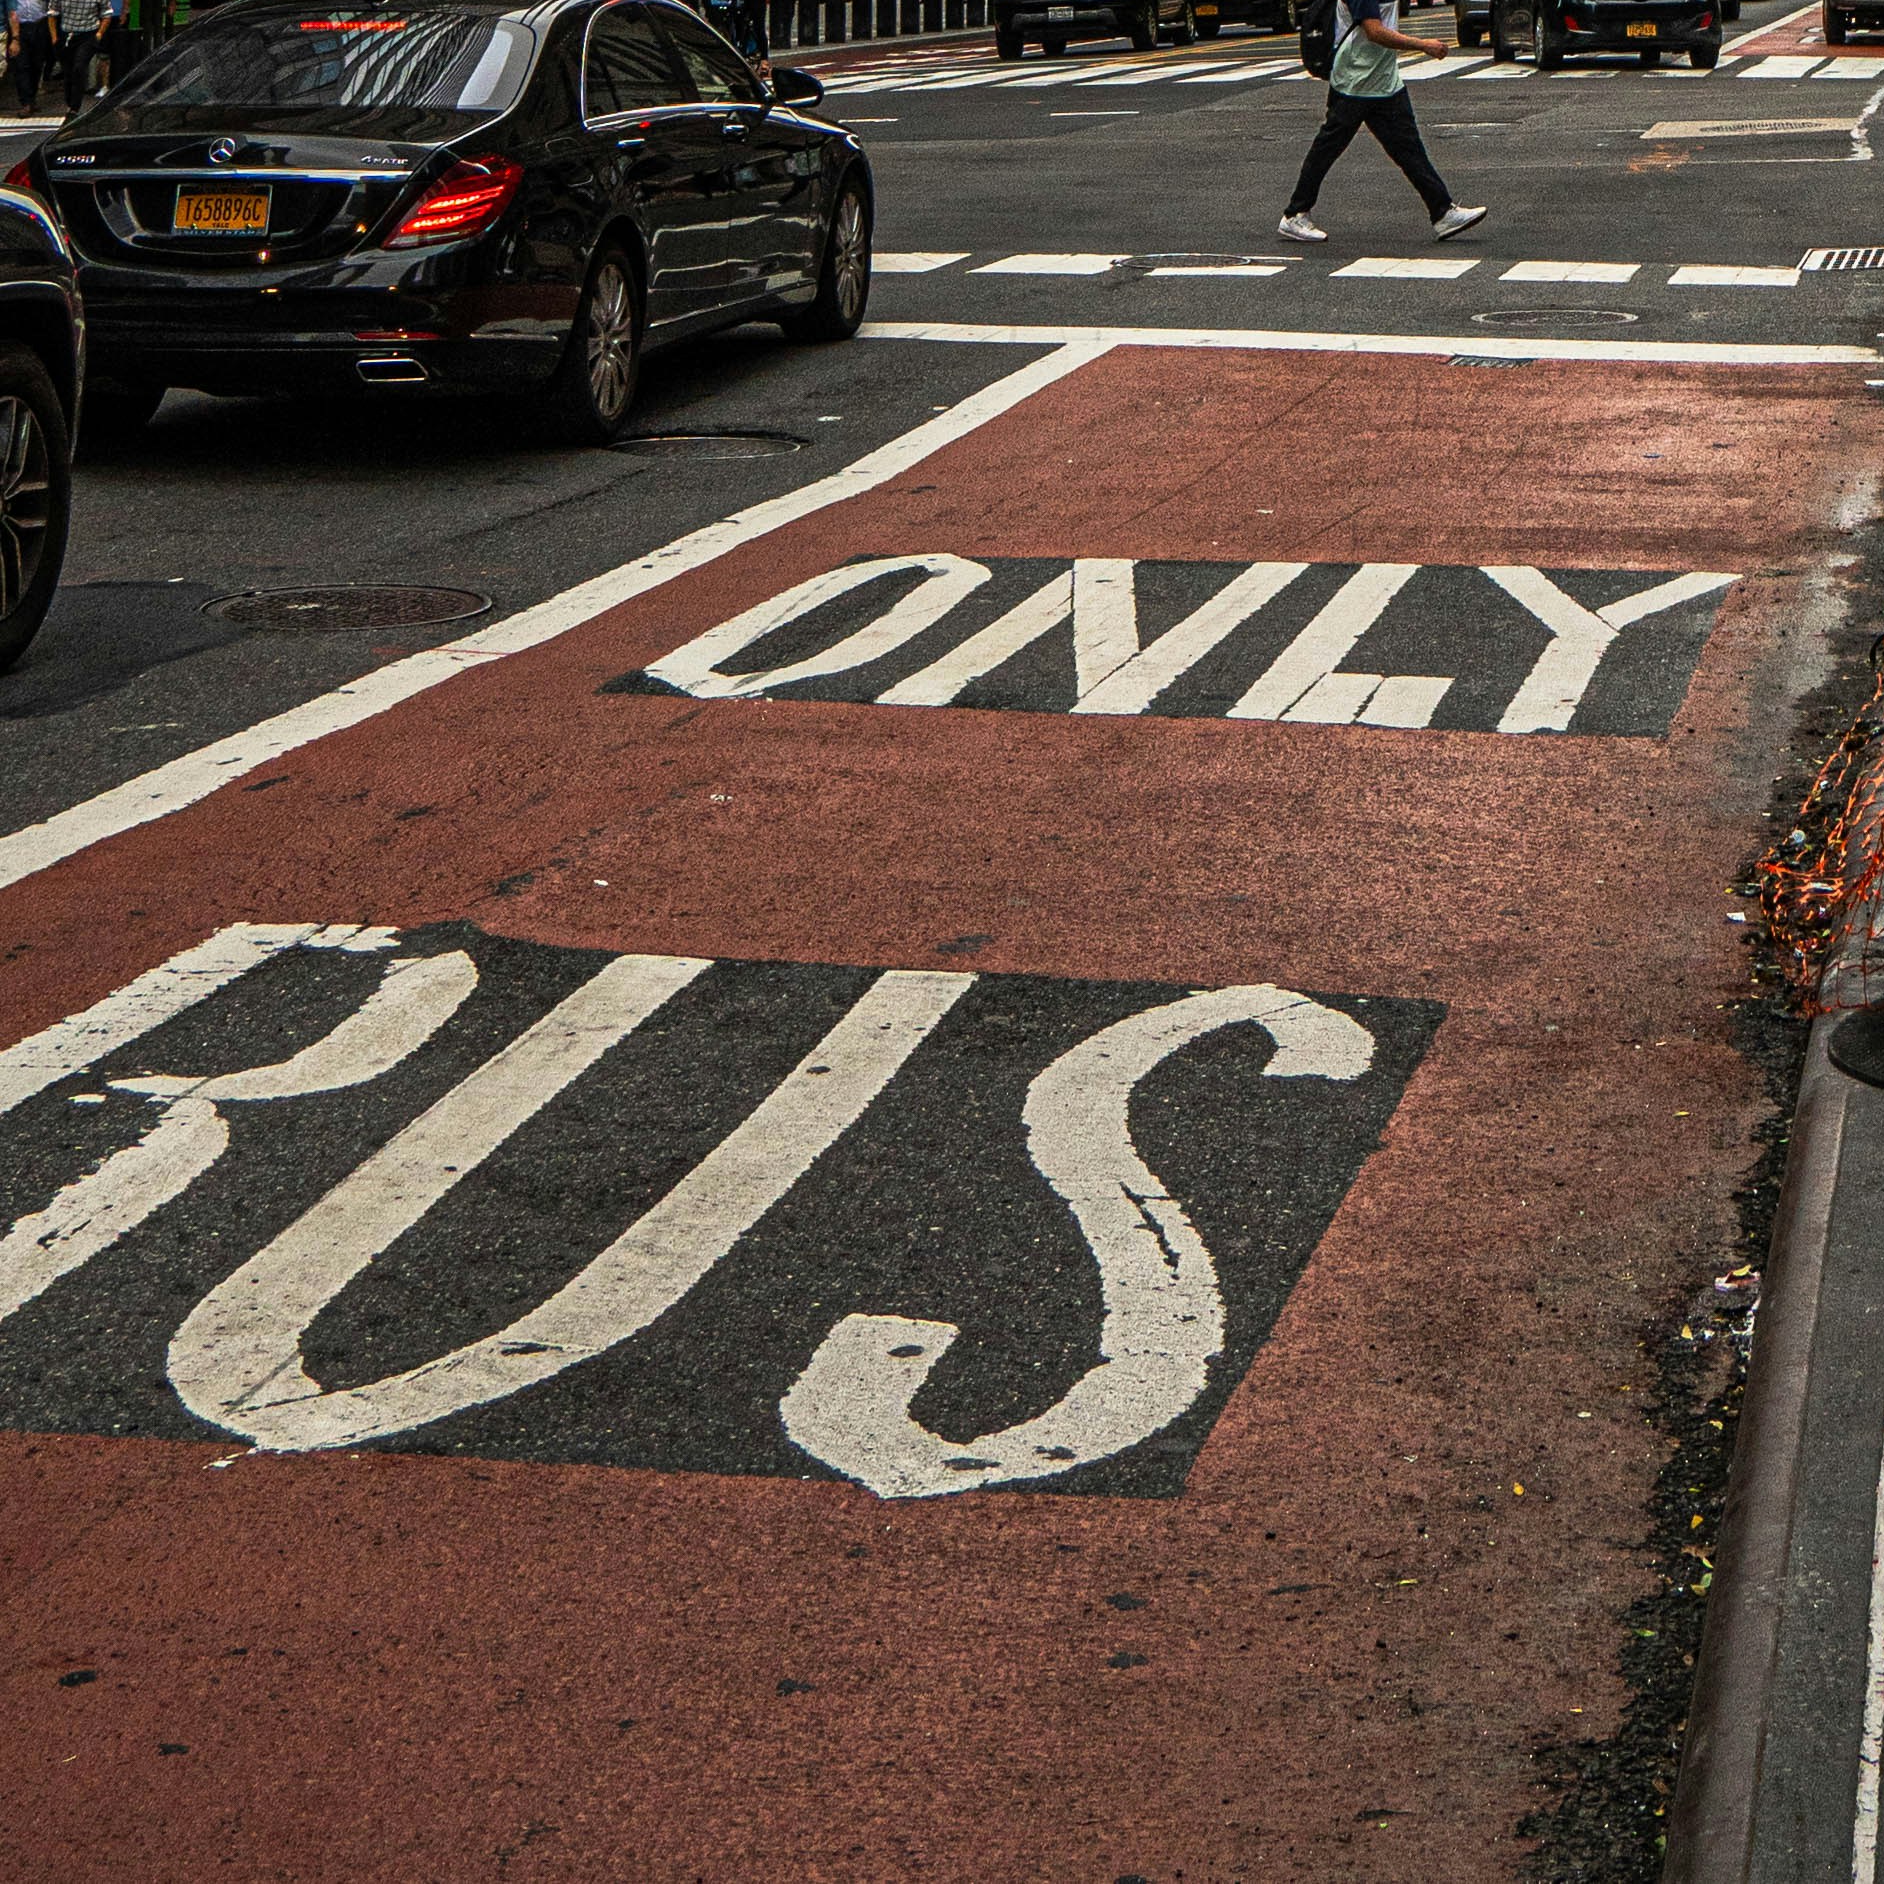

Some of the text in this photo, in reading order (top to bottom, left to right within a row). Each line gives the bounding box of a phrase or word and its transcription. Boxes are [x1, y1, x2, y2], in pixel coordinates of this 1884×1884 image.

[360, 155, 409, 165] 4MATIC
[184, 198, 262, 222] T658896C
[642, 551, 1742, 732] ONLY
